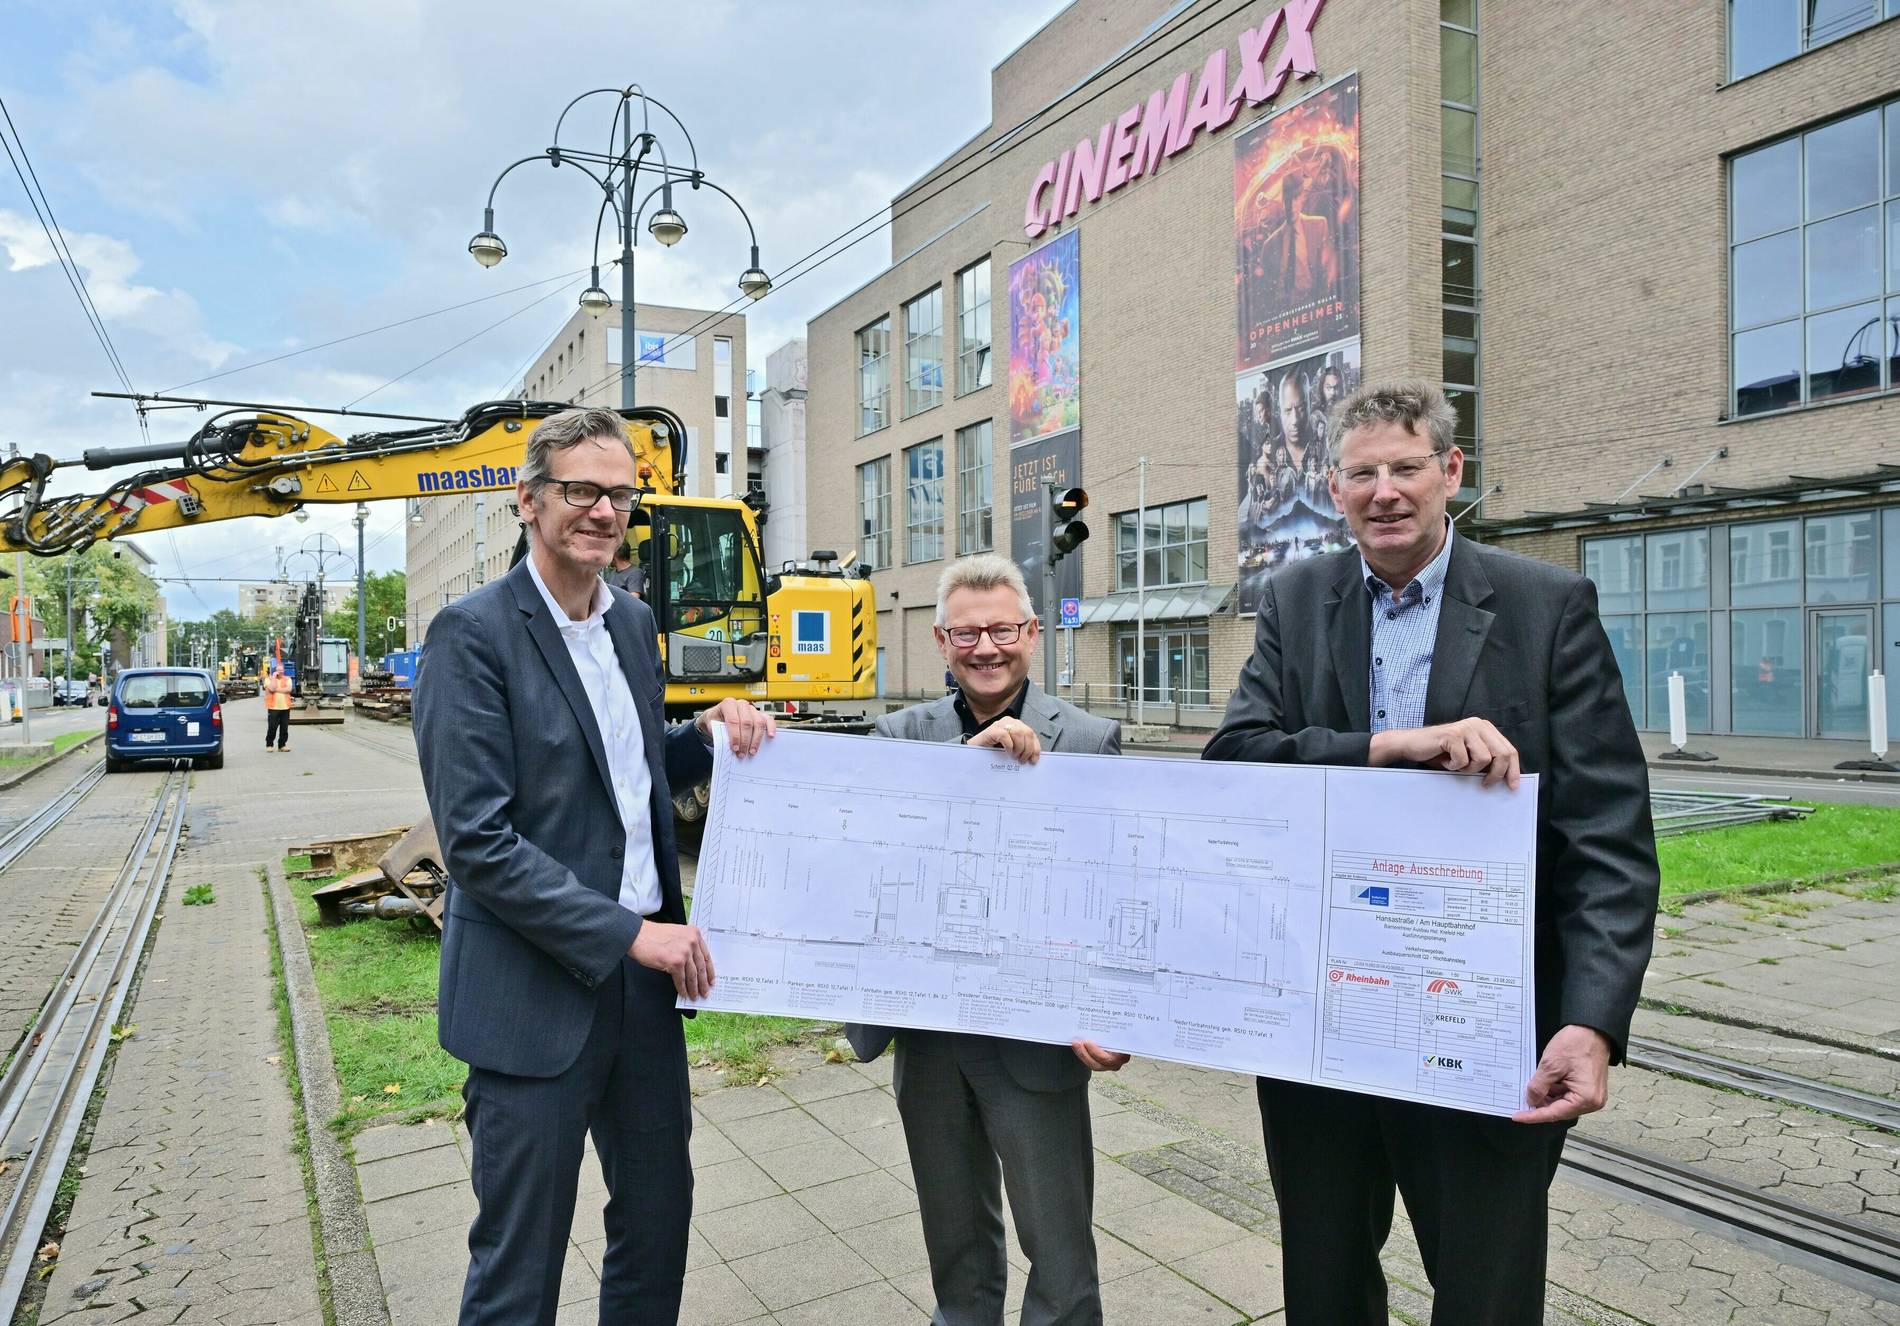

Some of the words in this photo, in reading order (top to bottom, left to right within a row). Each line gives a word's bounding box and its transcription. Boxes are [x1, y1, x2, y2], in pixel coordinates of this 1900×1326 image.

[1025, 0, 1326, 238] CINEMAXX
[1250, 302, 1344, 340] OPPENHEIMER
[1014, 460, 1038, 480] JETZT
[1042, 454, 1056, 472] IST
[708, 630, 722, 642] 20
[798, 643, 824, 652] maas
[1372, 858, 1404, 876] Anlage
[1410, 861, 1483, 882] Ausschreibung
[1376, 914, 1414, 925] Hansastraße
[1432, 920, 1476, 930] Hauptbahnhof
[1346, 973, 1390, 986] Rheinbahn
[1444, 988, 1462, 996] SWK
[1435, 1014, 1466, 1024] KREFELD
[1438, 1057, 1462, 1069] KBK
